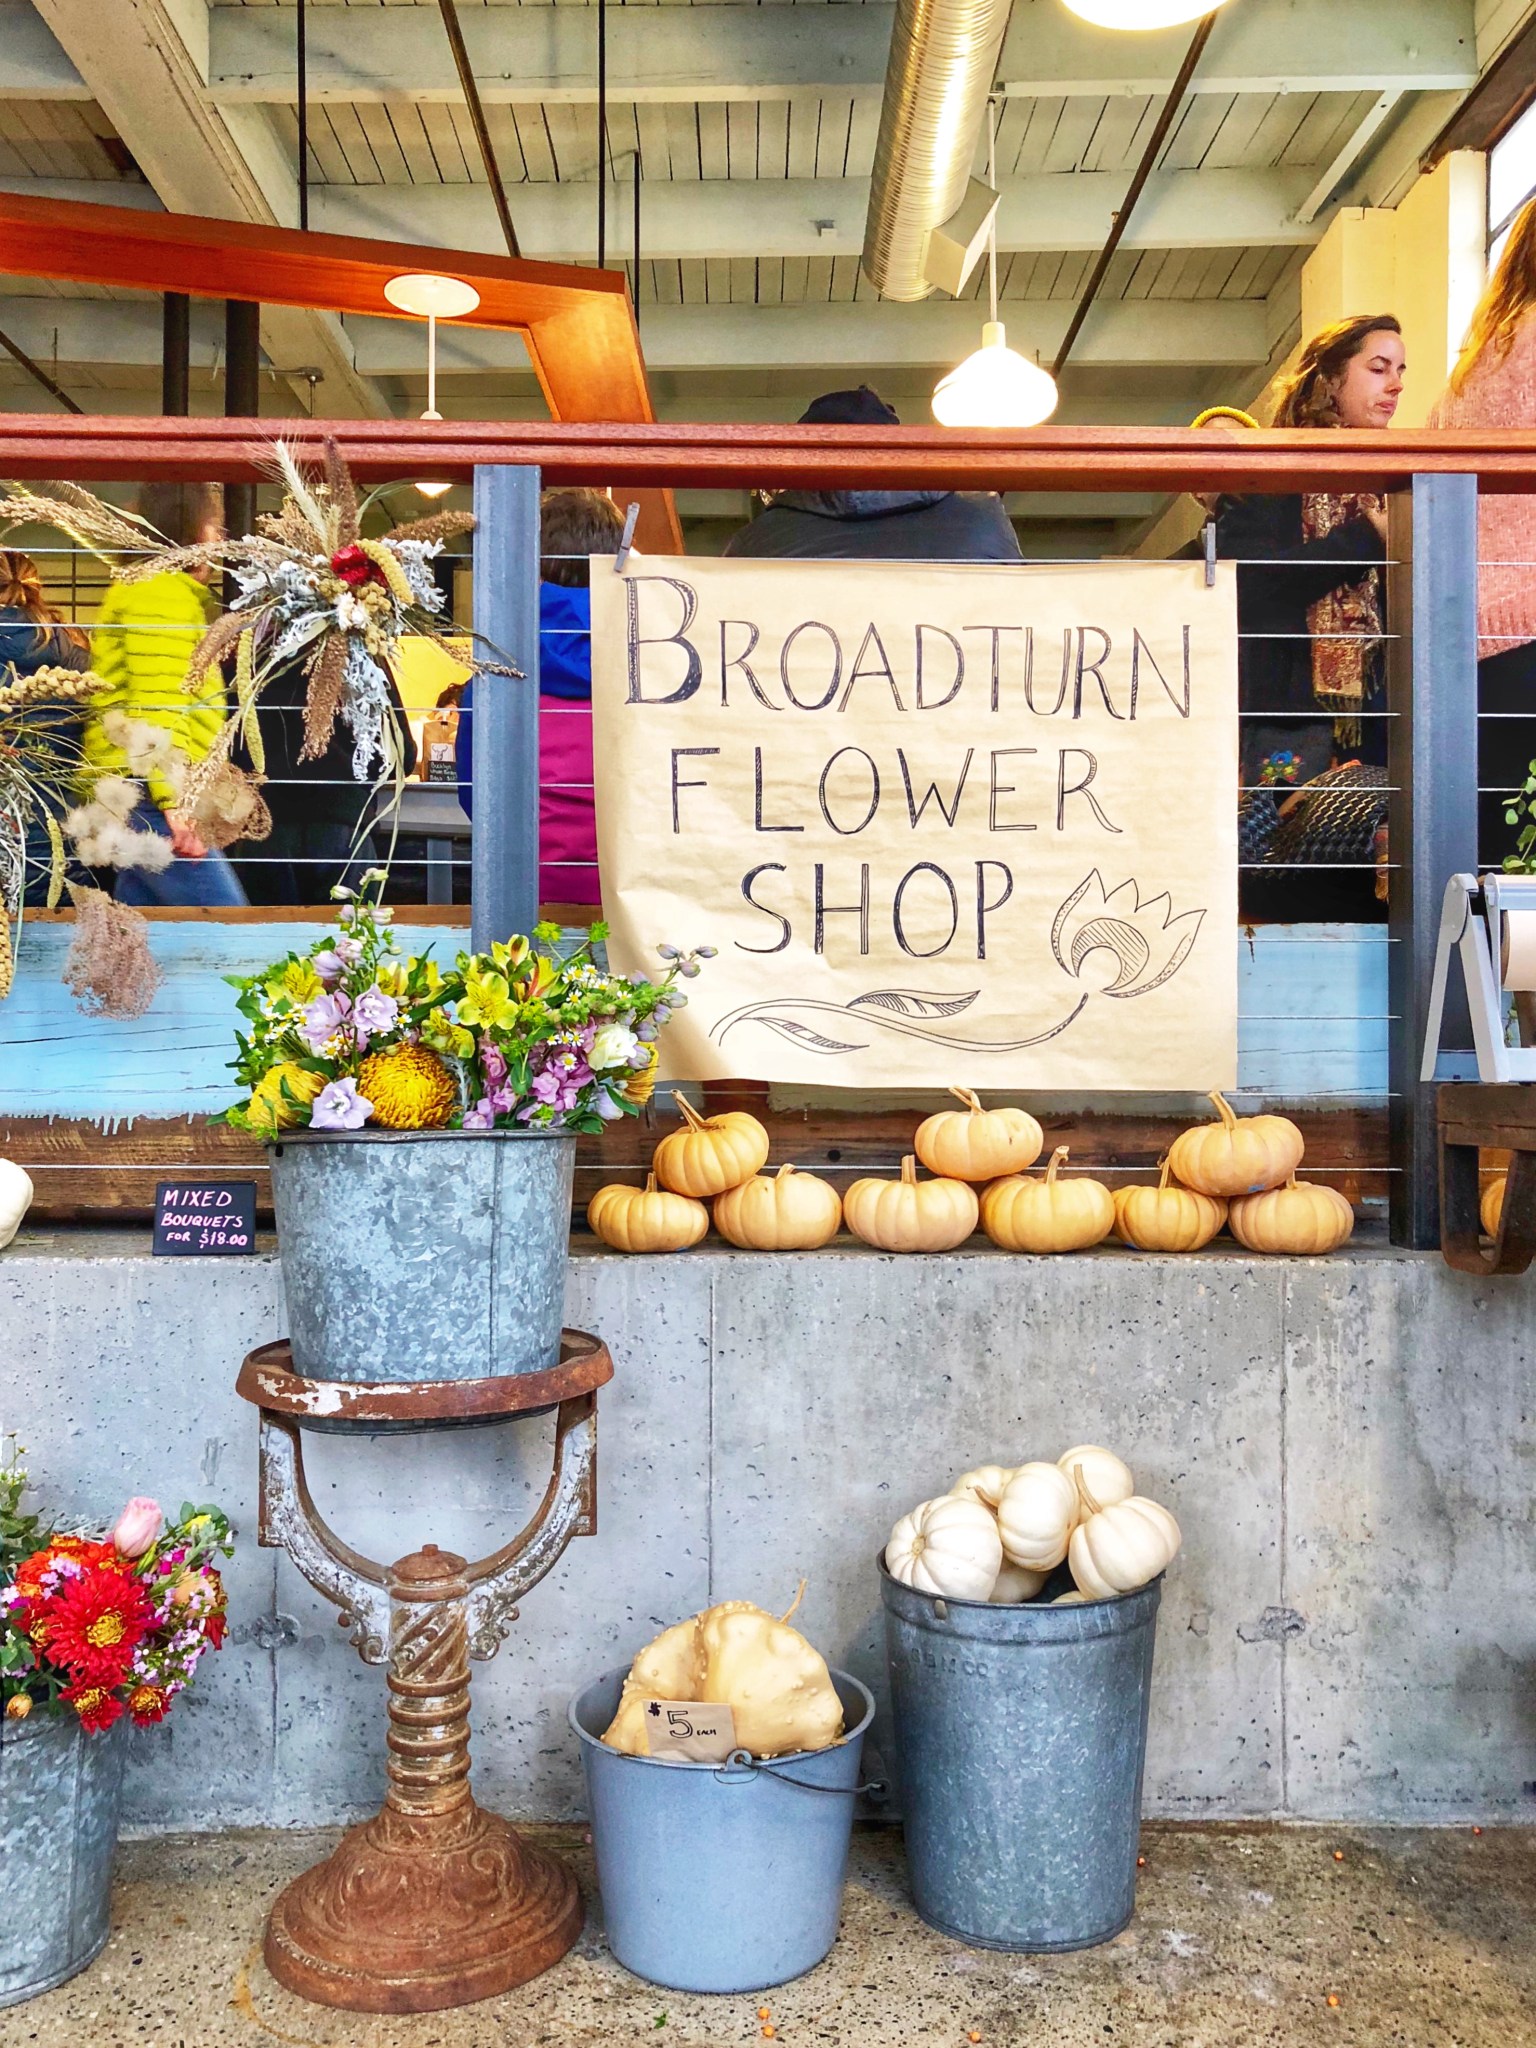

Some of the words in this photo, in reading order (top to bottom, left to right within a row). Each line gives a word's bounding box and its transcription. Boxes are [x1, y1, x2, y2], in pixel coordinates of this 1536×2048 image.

[622, 576, 1192, 721] BROADTURN
[671, 746, 1123, 835] FLOWER
[733, 860, 1014, 960] SHOP
[162, 1189, 233, 1208] MIXED
[160, 1212, 244, 1228] BOUQUETS
[166, 1231, 192, 1242] FOR
[198, 1228, 248, 1249] $18.00
[696, 1728, 717, 1737] EACH
